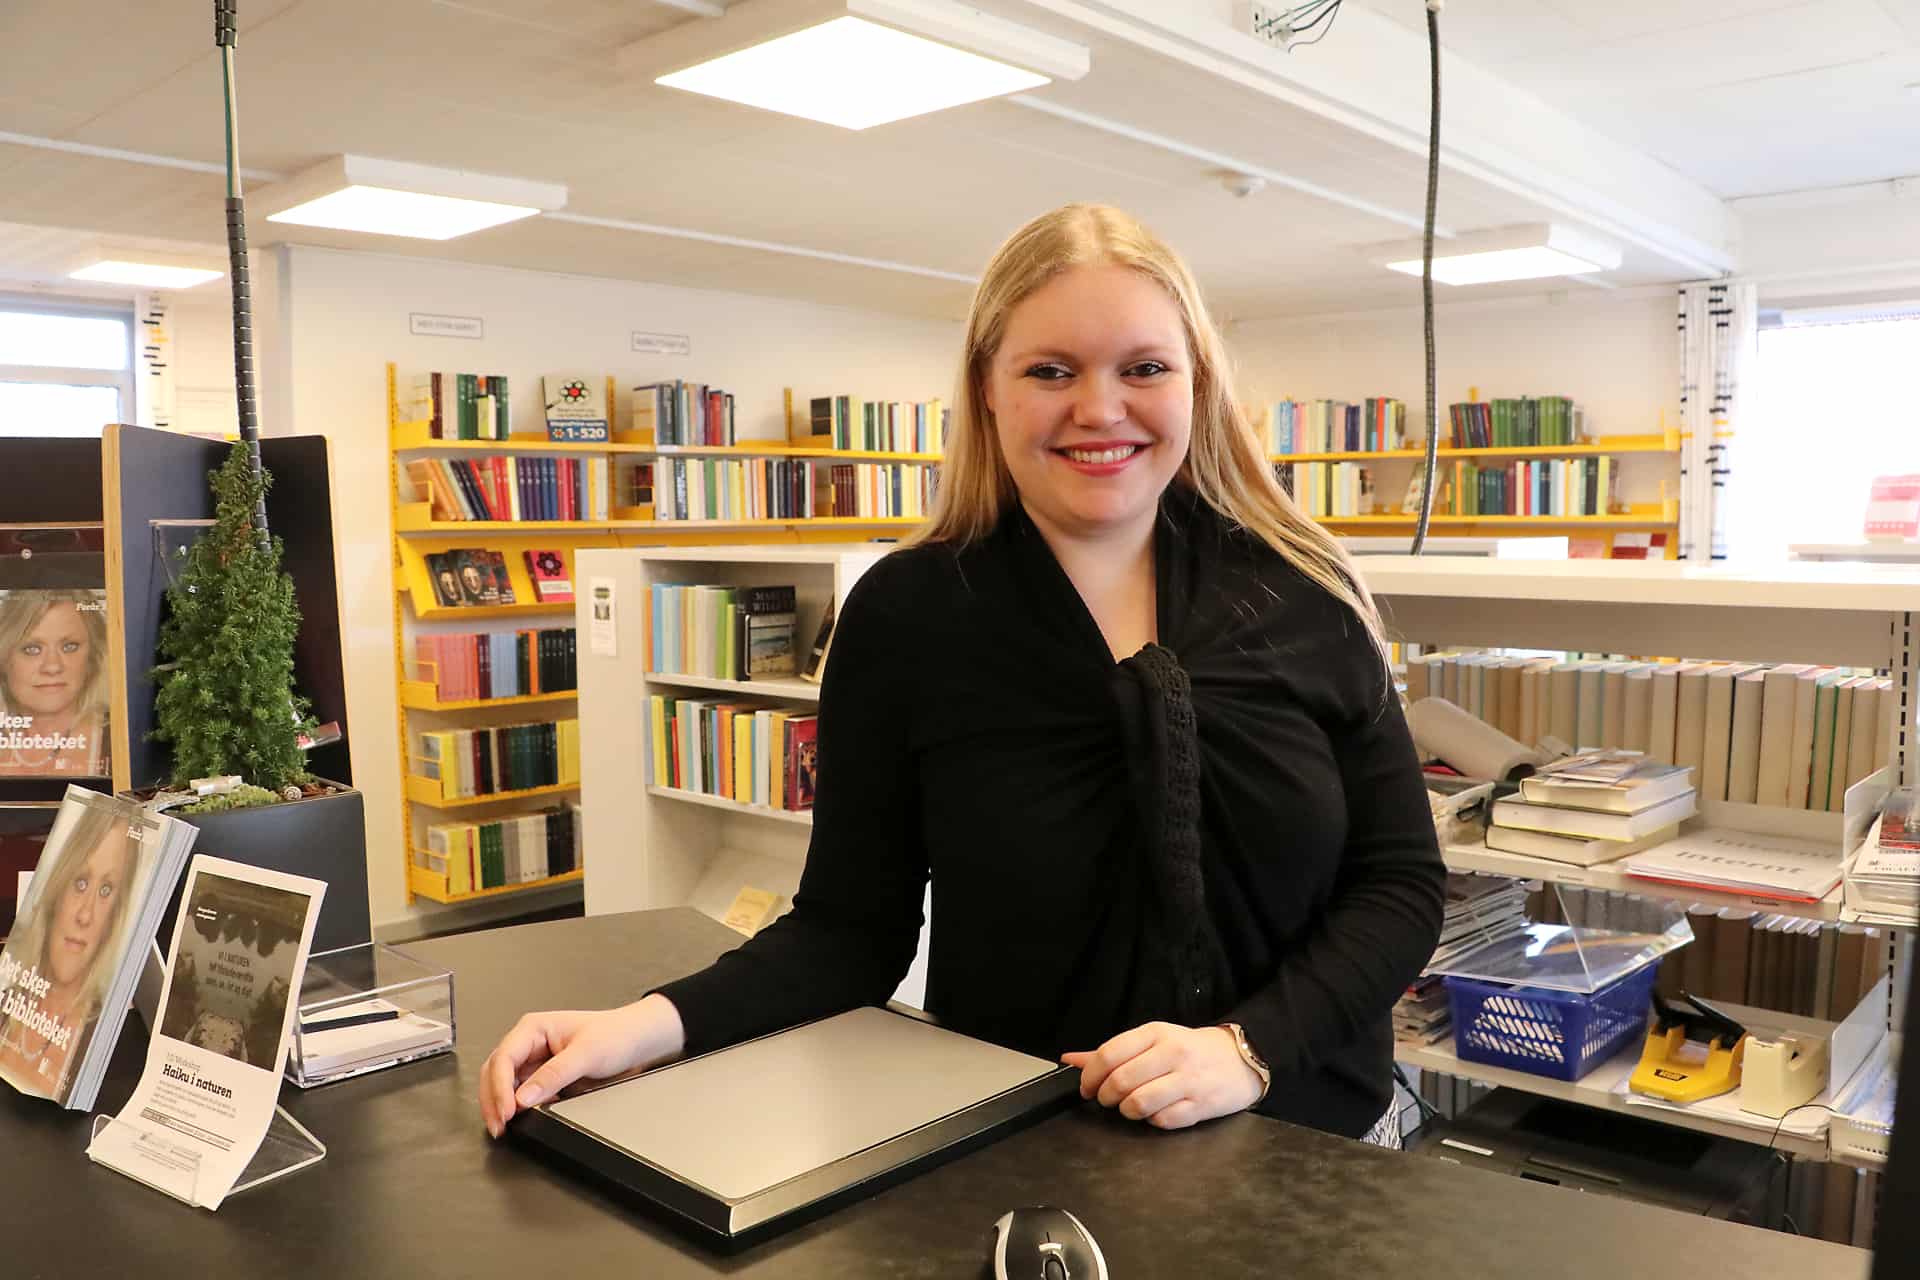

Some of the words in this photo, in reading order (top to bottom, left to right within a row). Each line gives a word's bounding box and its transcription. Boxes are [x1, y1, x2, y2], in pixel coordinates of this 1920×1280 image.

[19, 965, 51, 999] sker
[3, 989, 71, 1051] biblioteket
[163, 1063, 190, 1083] Haiku
[190, 1072, 197, 1085] i
[196, 1078, 233, 1099] naturen
